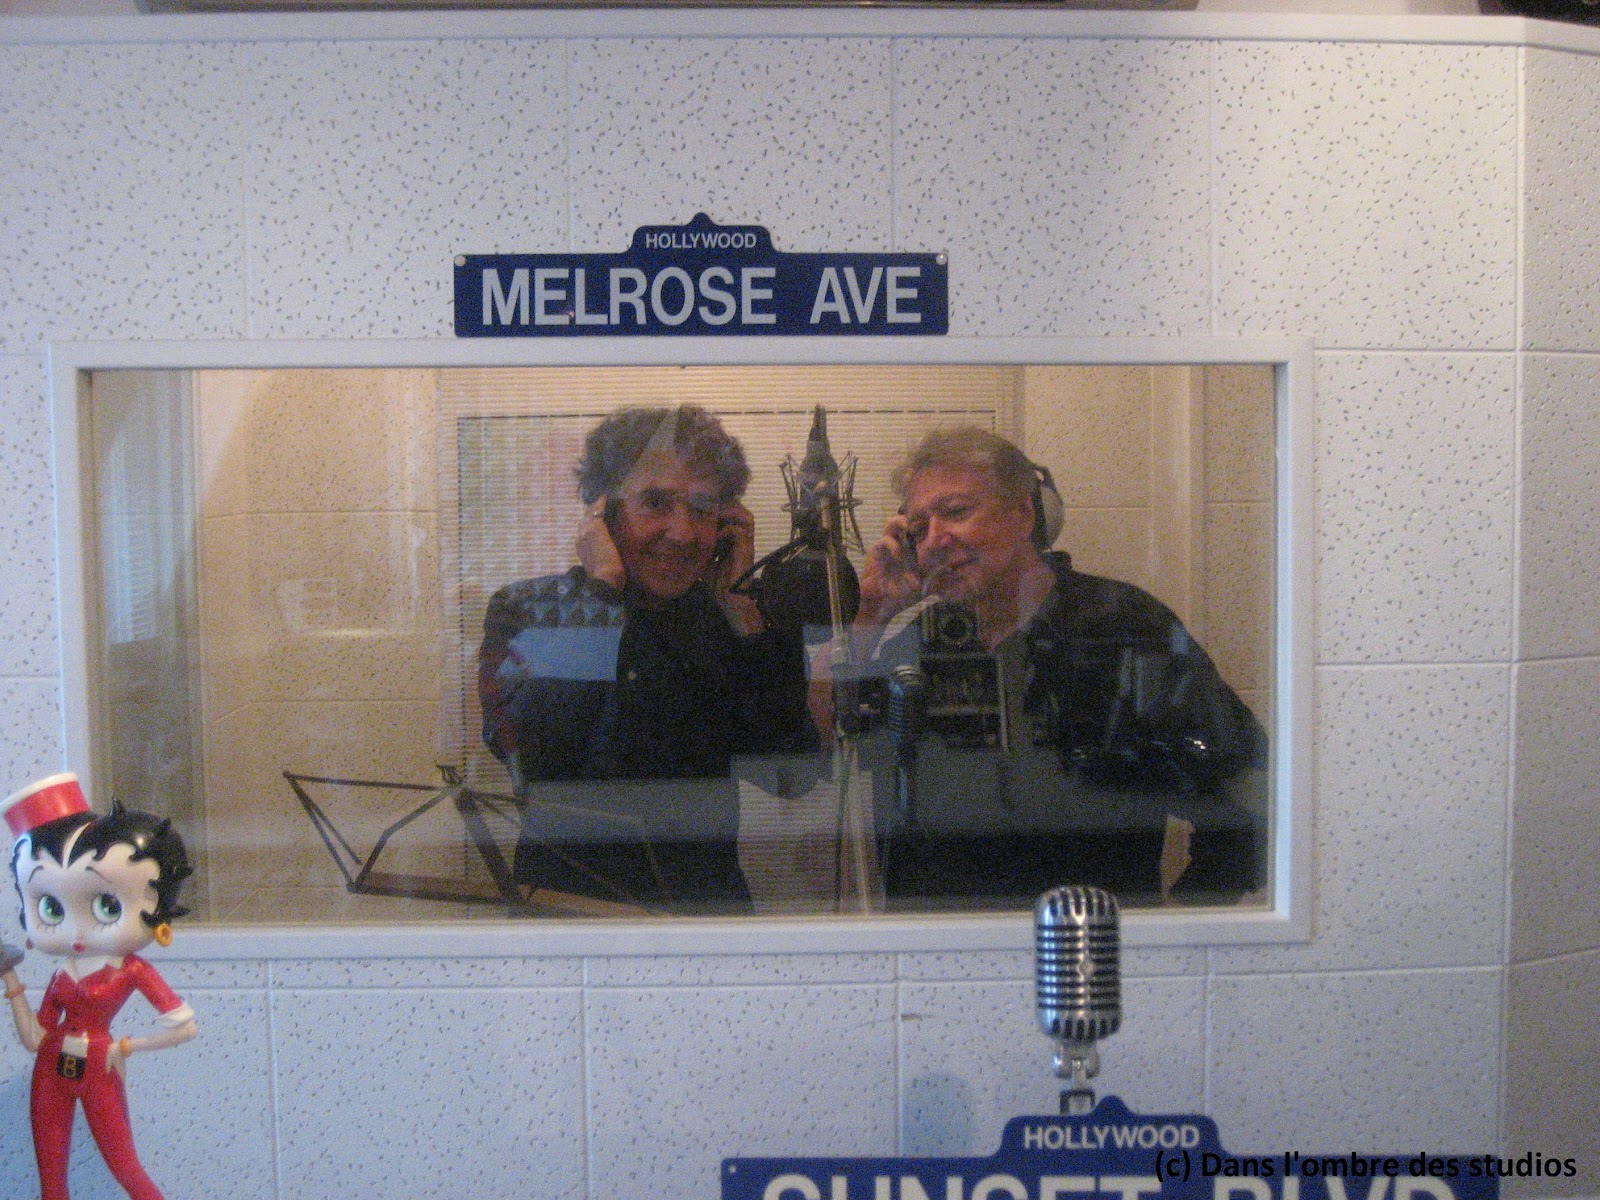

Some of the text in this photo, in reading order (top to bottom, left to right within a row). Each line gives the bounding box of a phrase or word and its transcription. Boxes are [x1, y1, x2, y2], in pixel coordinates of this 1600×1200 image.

[645, 232, 758, 249] HOLLYWOOD
[481, 265, 922, 326] MELROSE AVE
[1023, 1124, 1200, 1150] HOLLYWOOD
